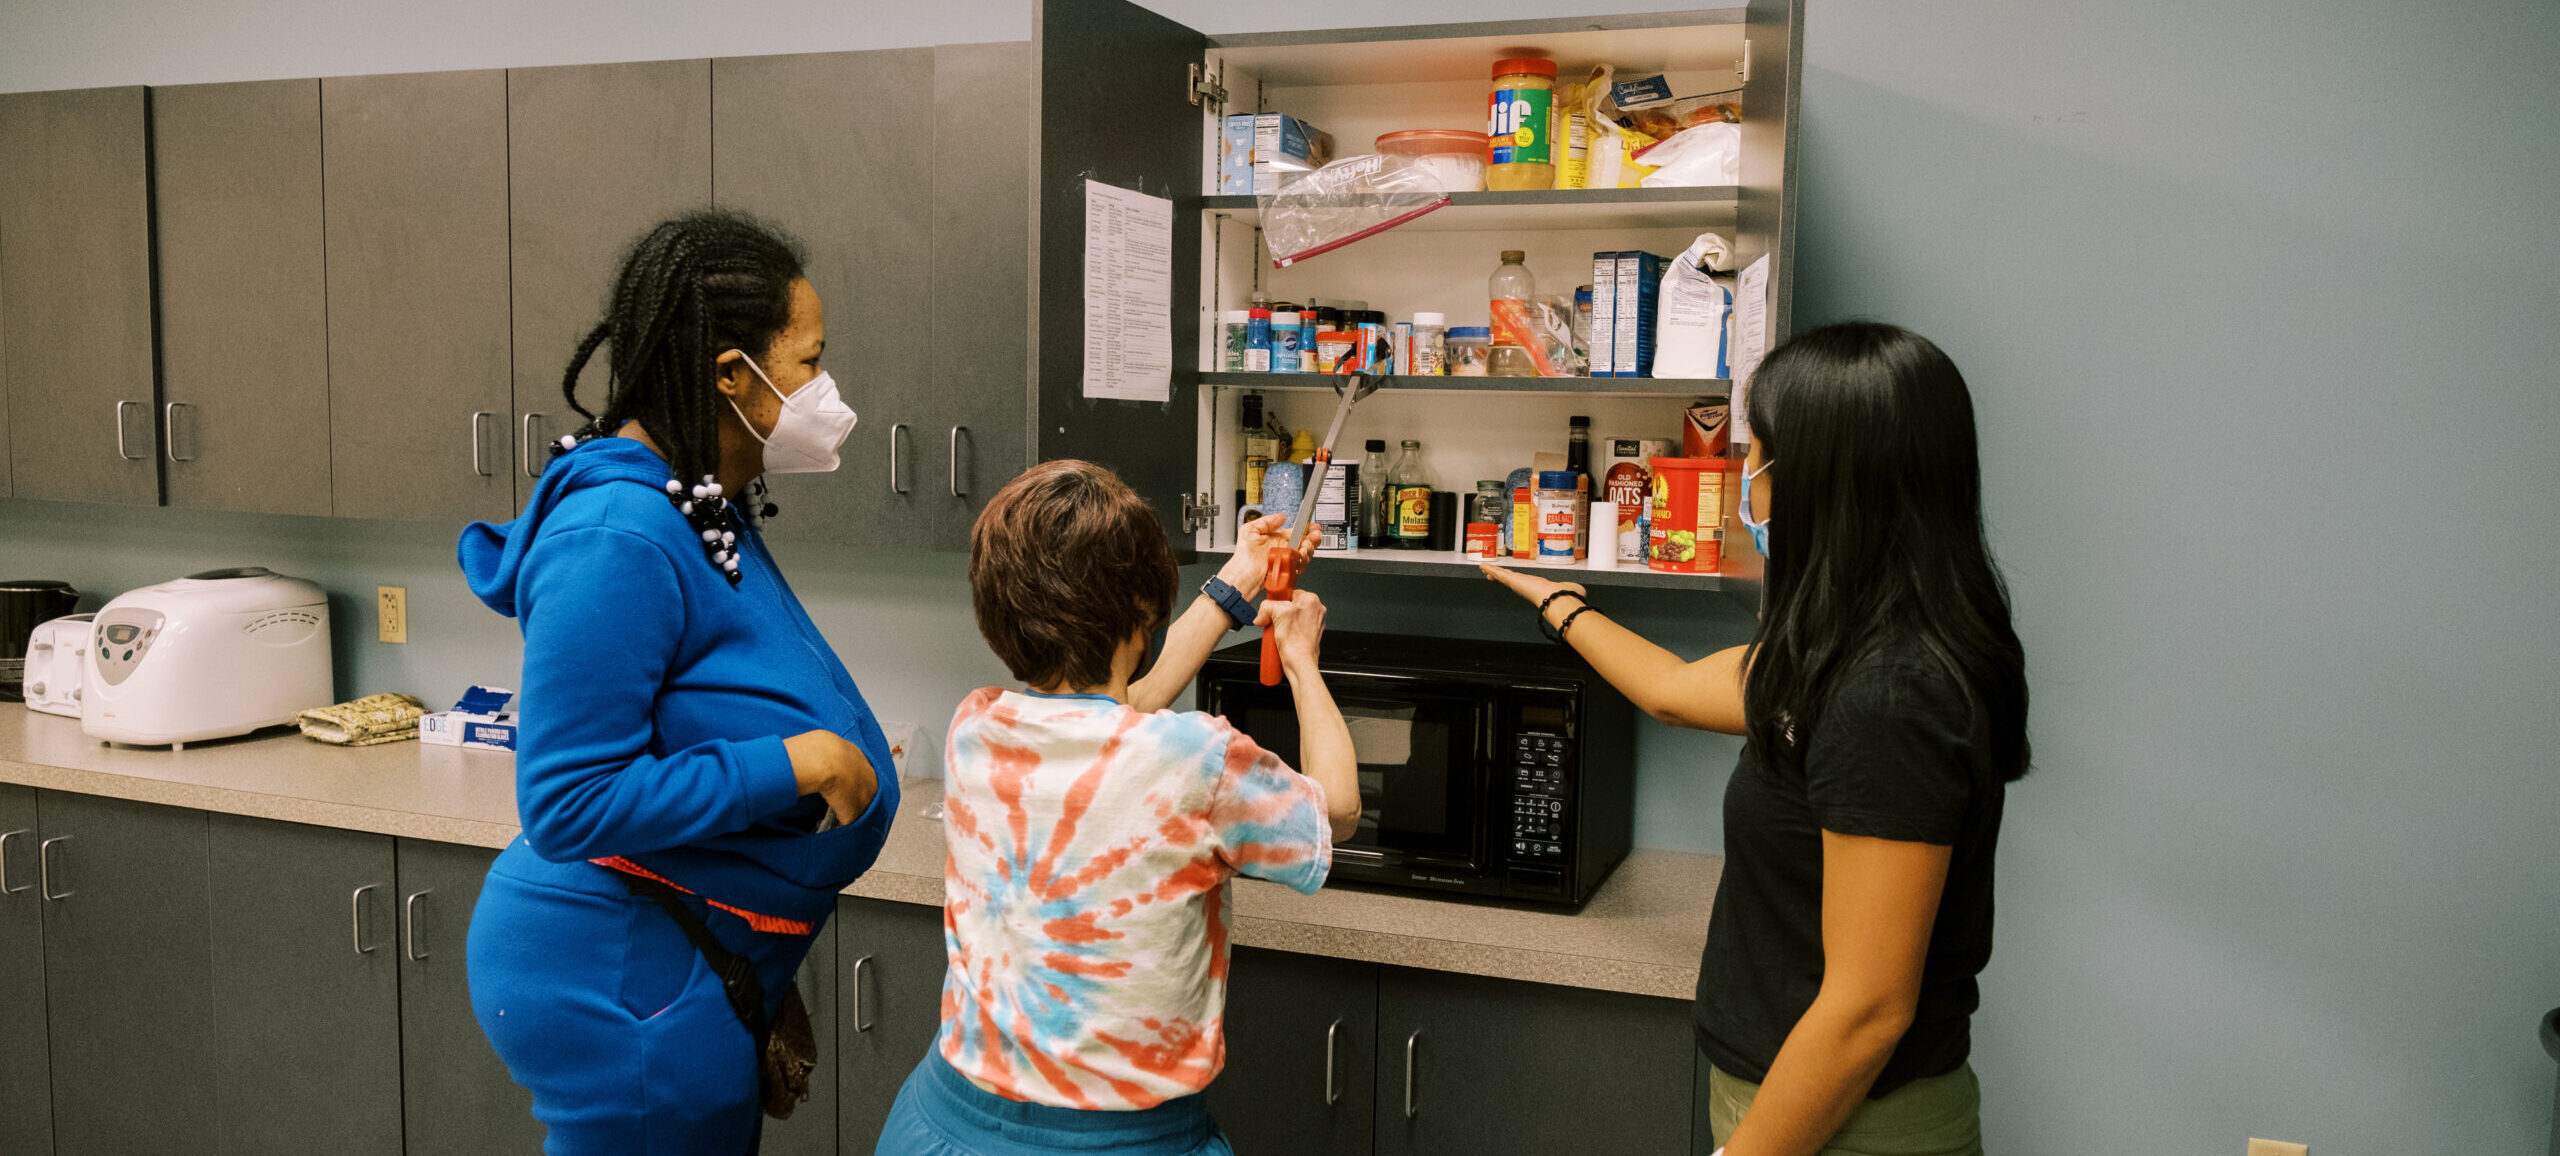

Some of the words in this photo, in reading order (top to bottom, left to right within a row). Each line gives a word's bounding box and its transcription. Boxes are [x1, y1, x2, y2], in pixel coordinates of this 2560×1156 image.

[1487, 99, 1532, 137] Jif
[1609, 487, 1641, 505] OATS
[424, 717, 448, 734] EDGE
